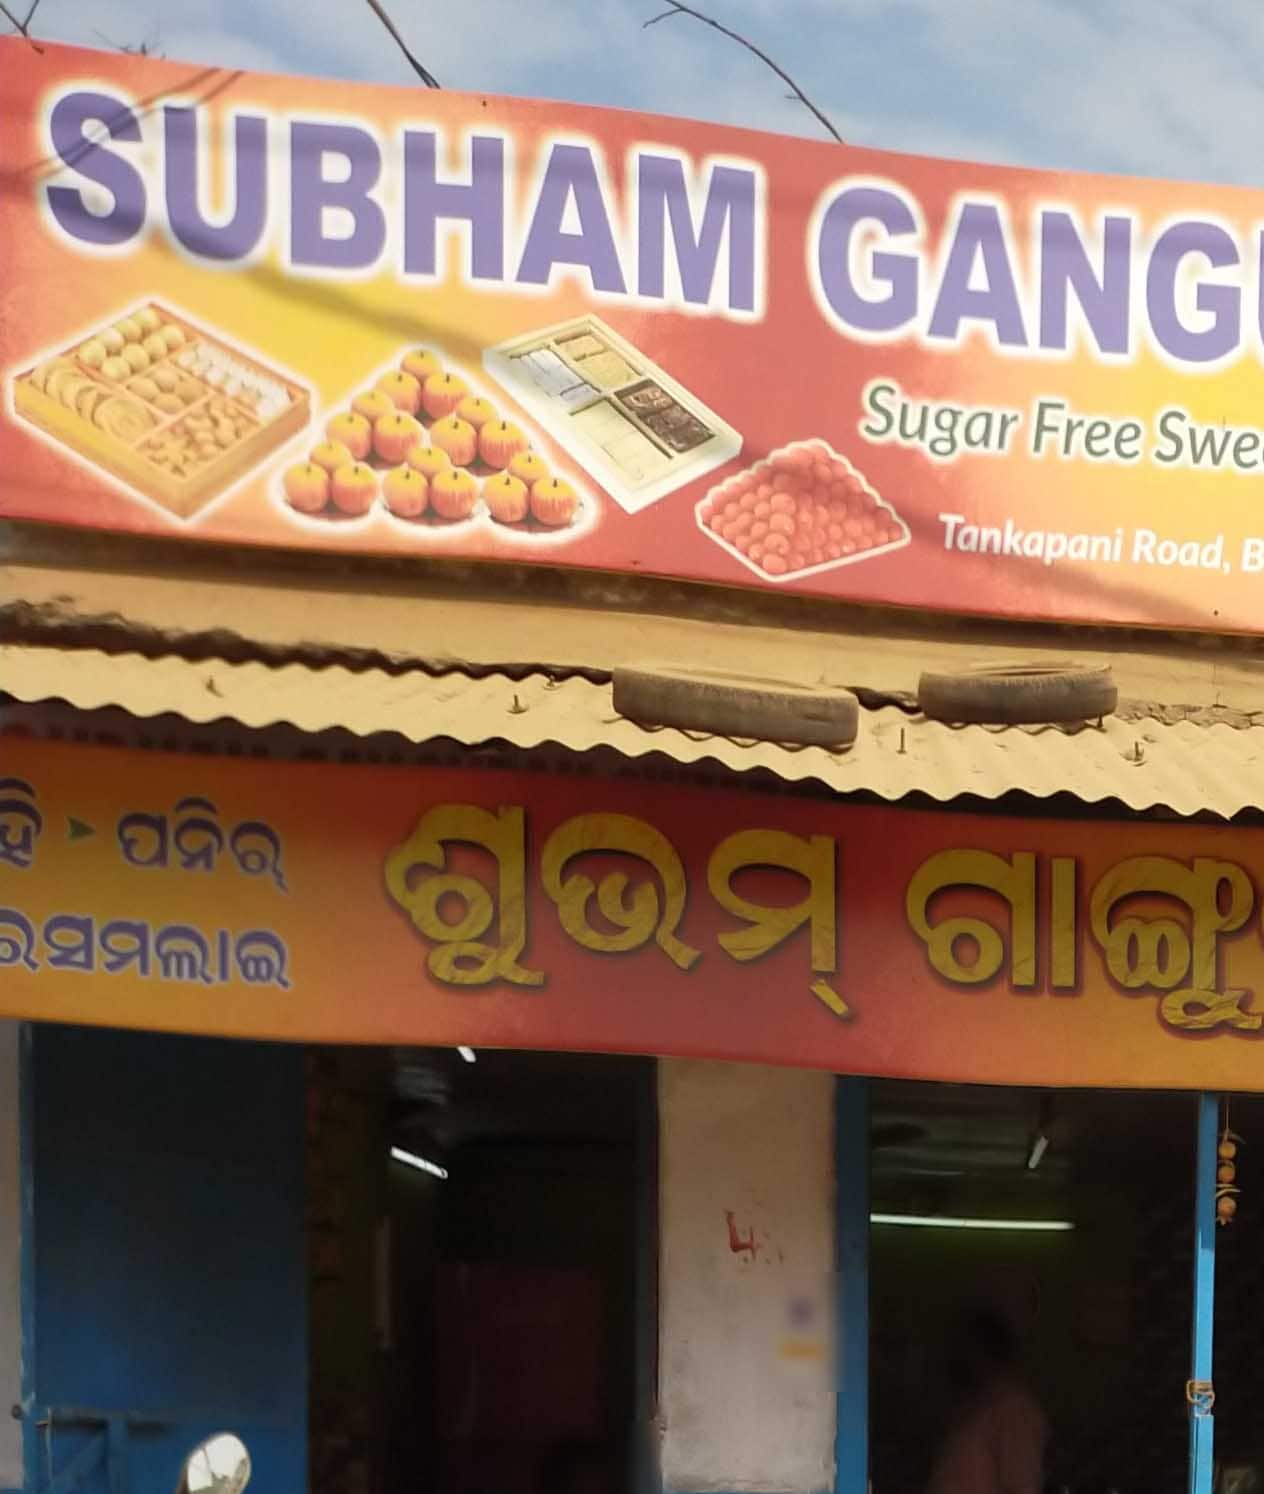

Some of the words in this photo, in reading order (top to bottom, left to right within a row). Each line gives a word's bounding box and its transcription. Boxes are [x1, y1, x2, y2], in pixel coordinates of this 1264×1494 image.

[46, 91, 757, 313] SUBHAM
[863, 384, 1018, 456] Sugar
[1033, 402, 1141, 460] Free
[939, 511, 1121, 566] Tankapani
[1132, 528, 1231, 575] Road,
[116, 796, 289, 892] ପନିର
[384, 803, 851, 1018] ଶୁଭମ୍
